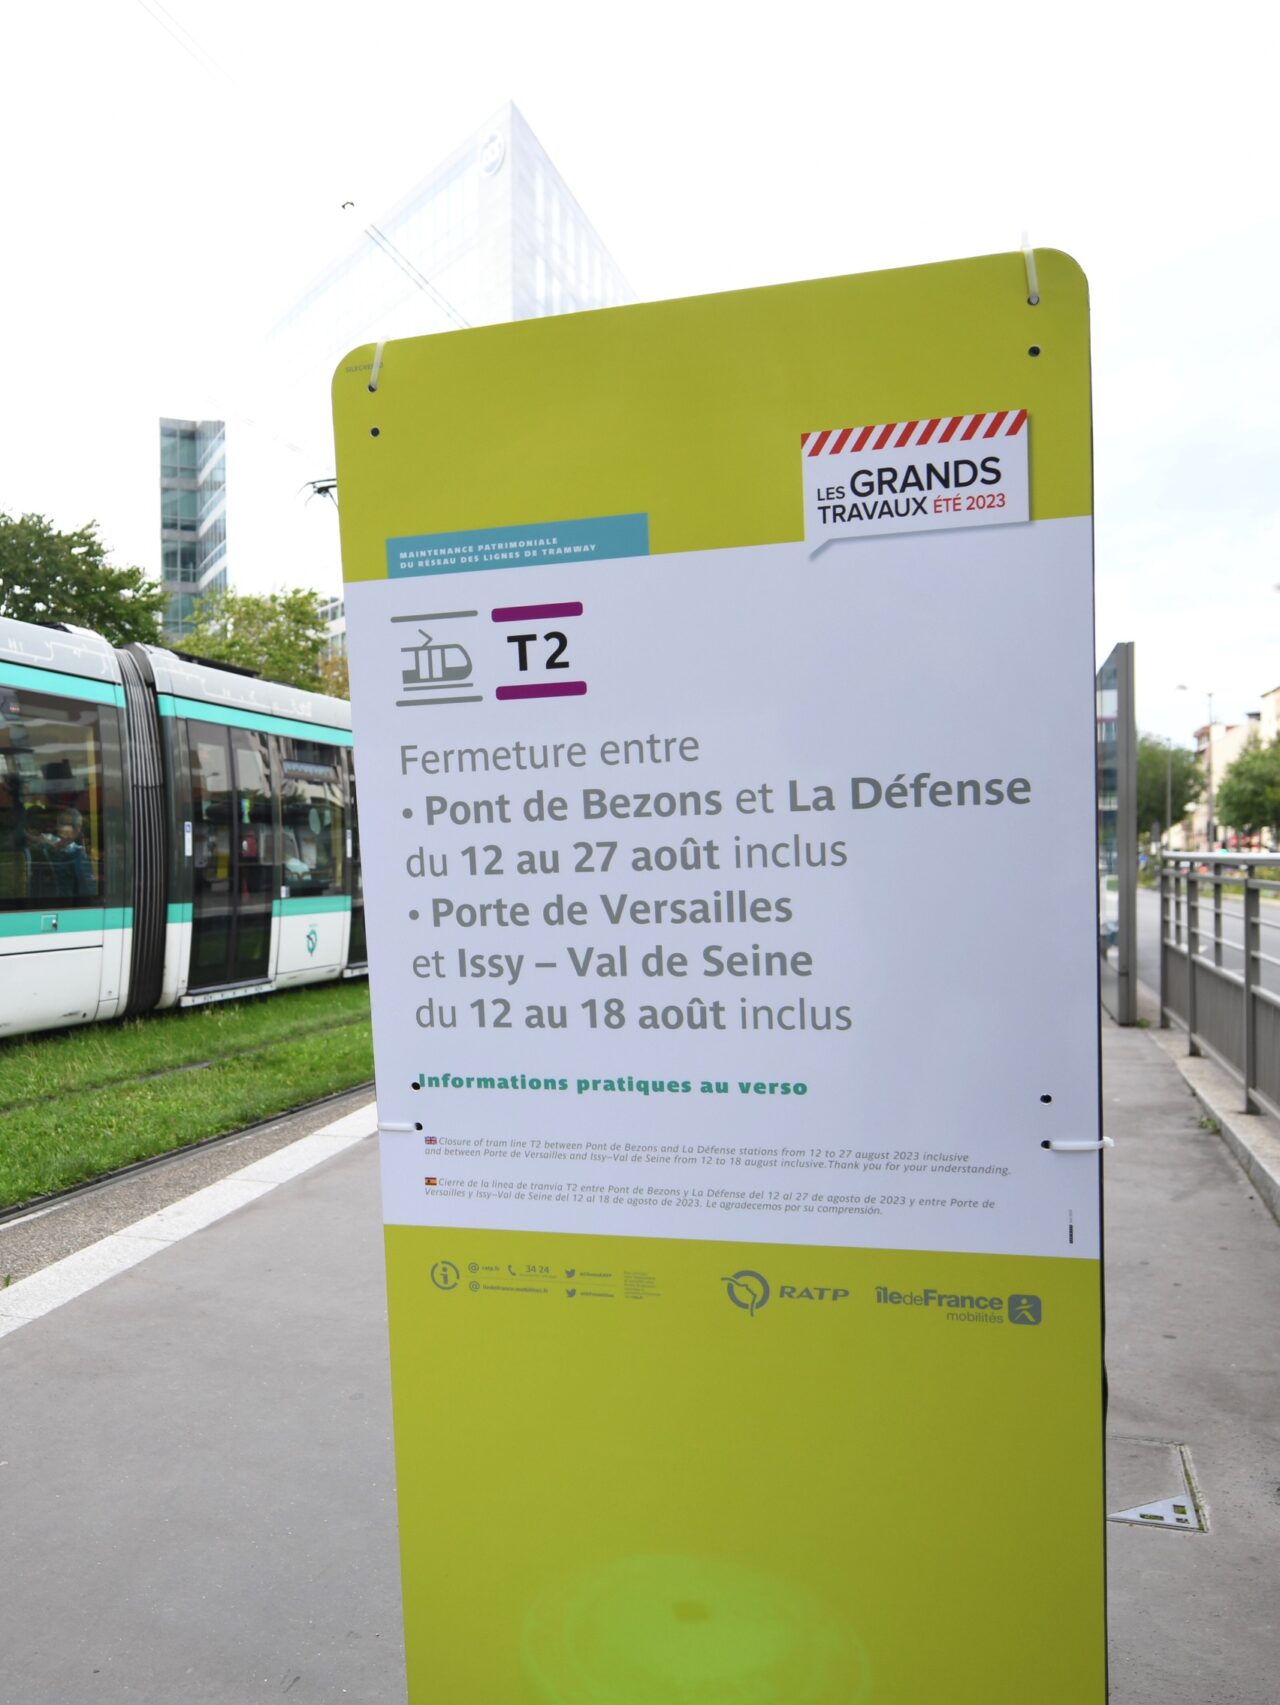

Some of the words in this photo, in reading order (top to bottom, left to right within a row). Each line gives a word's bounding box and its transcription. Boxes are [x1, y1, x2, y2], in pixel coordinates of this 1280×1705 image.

[817, 485, 845, 501] LES
[850, 456, 1002, 498] GRANDS
[817, 496, 928, 525] TRAVAUX
[933, 492, 962, 514] ÉTÉ
[966, 493, 1006, 511] 2023
[399, 545, 474, 559] MAINTENANCE
[478, 537, 558, 552] PATRIMONIALE
[400, 561, 414, 569] DU
[418, 556, 457, 568] RÉSEAU
[461, 554, 479, 564] DES
[483, 551, 520, 562] LIGNES
[525, 549, 538, 557] DE
[542, 543, 597, 556] TRAMWAY
[507, 630, 570, 672] T2
[400, 738, 587, 776] Fermeture
[600, 731, 700, 767] entre
[425, 793, 510, 826] Pont
[523, 788, 569, 822] de
[581, 785, 722, 820] Bezons
[735, 780, 774, 814] et
[789, 778, 835, 812] La
[851, 771, 1032, 811] Défense
[406, 845, 449, 878] du
[461, 845, 504, 877] 12
[517, 848, 560, 874] au
[573, 841, 618, 873] 27
[631, 838, 721, 873] août
[734, 833, 848, 869] inclus
[431, 897, 530, 929] Porte
[542, 892, 588, 926] de
[600, 889, 794, 926] Versailles
[412, 950, 446, 978] et
[457, 947, 524, 986] Issy
[567, 945, 629, 978] Val
[641, 944, 688, 977] de
[702, 944, 814, 977] Seine
[415, 998, 457, 1029] du
[469, 1000, 513, 1029] 12
[524, 1004, 568, 1029] au
[580, 998, 626, 1029] 18
[638, 995, 727, 1030] août
[739, 994, 853, 1032] inclus
[419, 1073, 569, 1092] Informations
[576, 1075, 692, 1098] pratiques
[700, 1080, 731, 1096] au
[738, 1080, 808, 1096] verso
[425, 1146, 441, 1155] and
[444, 1147, 481, 1157] between
[483, 1149, 508, 1158] Porte
[510, 1149, 521, 1158] de
[523, 1149, 567, 1160] Versailles
[569, 1151, 587, 1160] and
[631, 1154, 643, 1163] de
[645, 1154, 671, 1163] Seine
[673, 1155, 697, 1164] from
[701, 1156, 713, 1165] 12
[715, 1157, 726, 1166] to
[730, 1157, 741, 1166] 18
[744, 1158, 778, 1168] august
[863, 1162, 881, 1172] you
[885, 1162, 900, 1171] for
[903, 1163, 928, 1173] your
[931, 1164, 1011, 1177] understanding.
[439, 1136, 471, 1146] Closure
[474, 1137, 483, 1147] of
[486, 1139, 507, 1148] tram
[510, 1138, 527, 1148] line
[530, 1140, 542, 1149] T2
[544, 1140, 583, 1150] between
[585, 1142, 608, 1151] Pont
[610, 1142, 622, 1151] de
[625, 1143, 658, 1153] Bezons
[661, 1144, 680, 1153] and
[682, 1145, 694, 1153] La
[739, 1147, 778, 1157] stations
[781, 1147, 806, 1157] from
[810, 1149, 822, 1158] 12
[825, 1149, 835, 1158] to
[838, 1149, 852, 1158] 27
[855, 1151, 890, 1161] august
[893, 1151, 920, 1161] 2023
[923, 1152, 969, 1162] inclusive
[424, 1187, 465, 1197] Versailles
[468, 1190, 473, 1198] y
[515, 1191, 525, 1200] de
[528, 1191, 552, 1201] Seine
[555, 1192, 569, 1201] del
[573, 1194, 583, 1203] 12
[586, 1195, 595, 1203] al
[600, 1195, 610, 1204] 18
[613, 1195, 625, 1204] de
[627, 1197, 658, 1207] agosto
[661, 1198, 672, 1206] de
[706, 1199, 717, 1208] Le
[720, 1201, 781, 1212] agradecemos
[784, 1203, 800, 1213] por
[803, 1204, 814, 1212] su
[439, 1178, 465, 1188] Cierre
[468, 1178, 478, 1188] de
[481, 1179, 489, 1188] la
[517, 1180, 528, 1190] de
[566, 1183, 577, 1192] T2
[580, 1185, 604, 1193] entre
[608, 1185, 629, 1194] Pont
[632, 1186, 645, 1195] de
[647, 1187, 680, 1197] Bezons
[683, 1189, 689, 1198] y
[692, 1188, 703, 1197] La
[749, 1190, 764, 1200] del
[768, 1191, 779, 1200] 12
[783, 1192, 792, 1201] al
[796, 1192, 808, 1201] 27
[812, 1193, 824, 1202] de
[827, 1194, 860, 1204] agosto
[864, 1195, 877, 1204] de
[880, 1195, 906, 1205] 2023
[909, 1198, 915, 1207] y
[918, 1198, 947, 1207] entre
[950, 1198, 978, 1208] Porte
[982, 1199, 995, 1209] de
[526, 1264, 537, 1273] 34
[538, 1265, 550, 1274] 24
[779, 1285, 850, 1301] RATP
[946, 1311, 1004, 1324] mobilités
